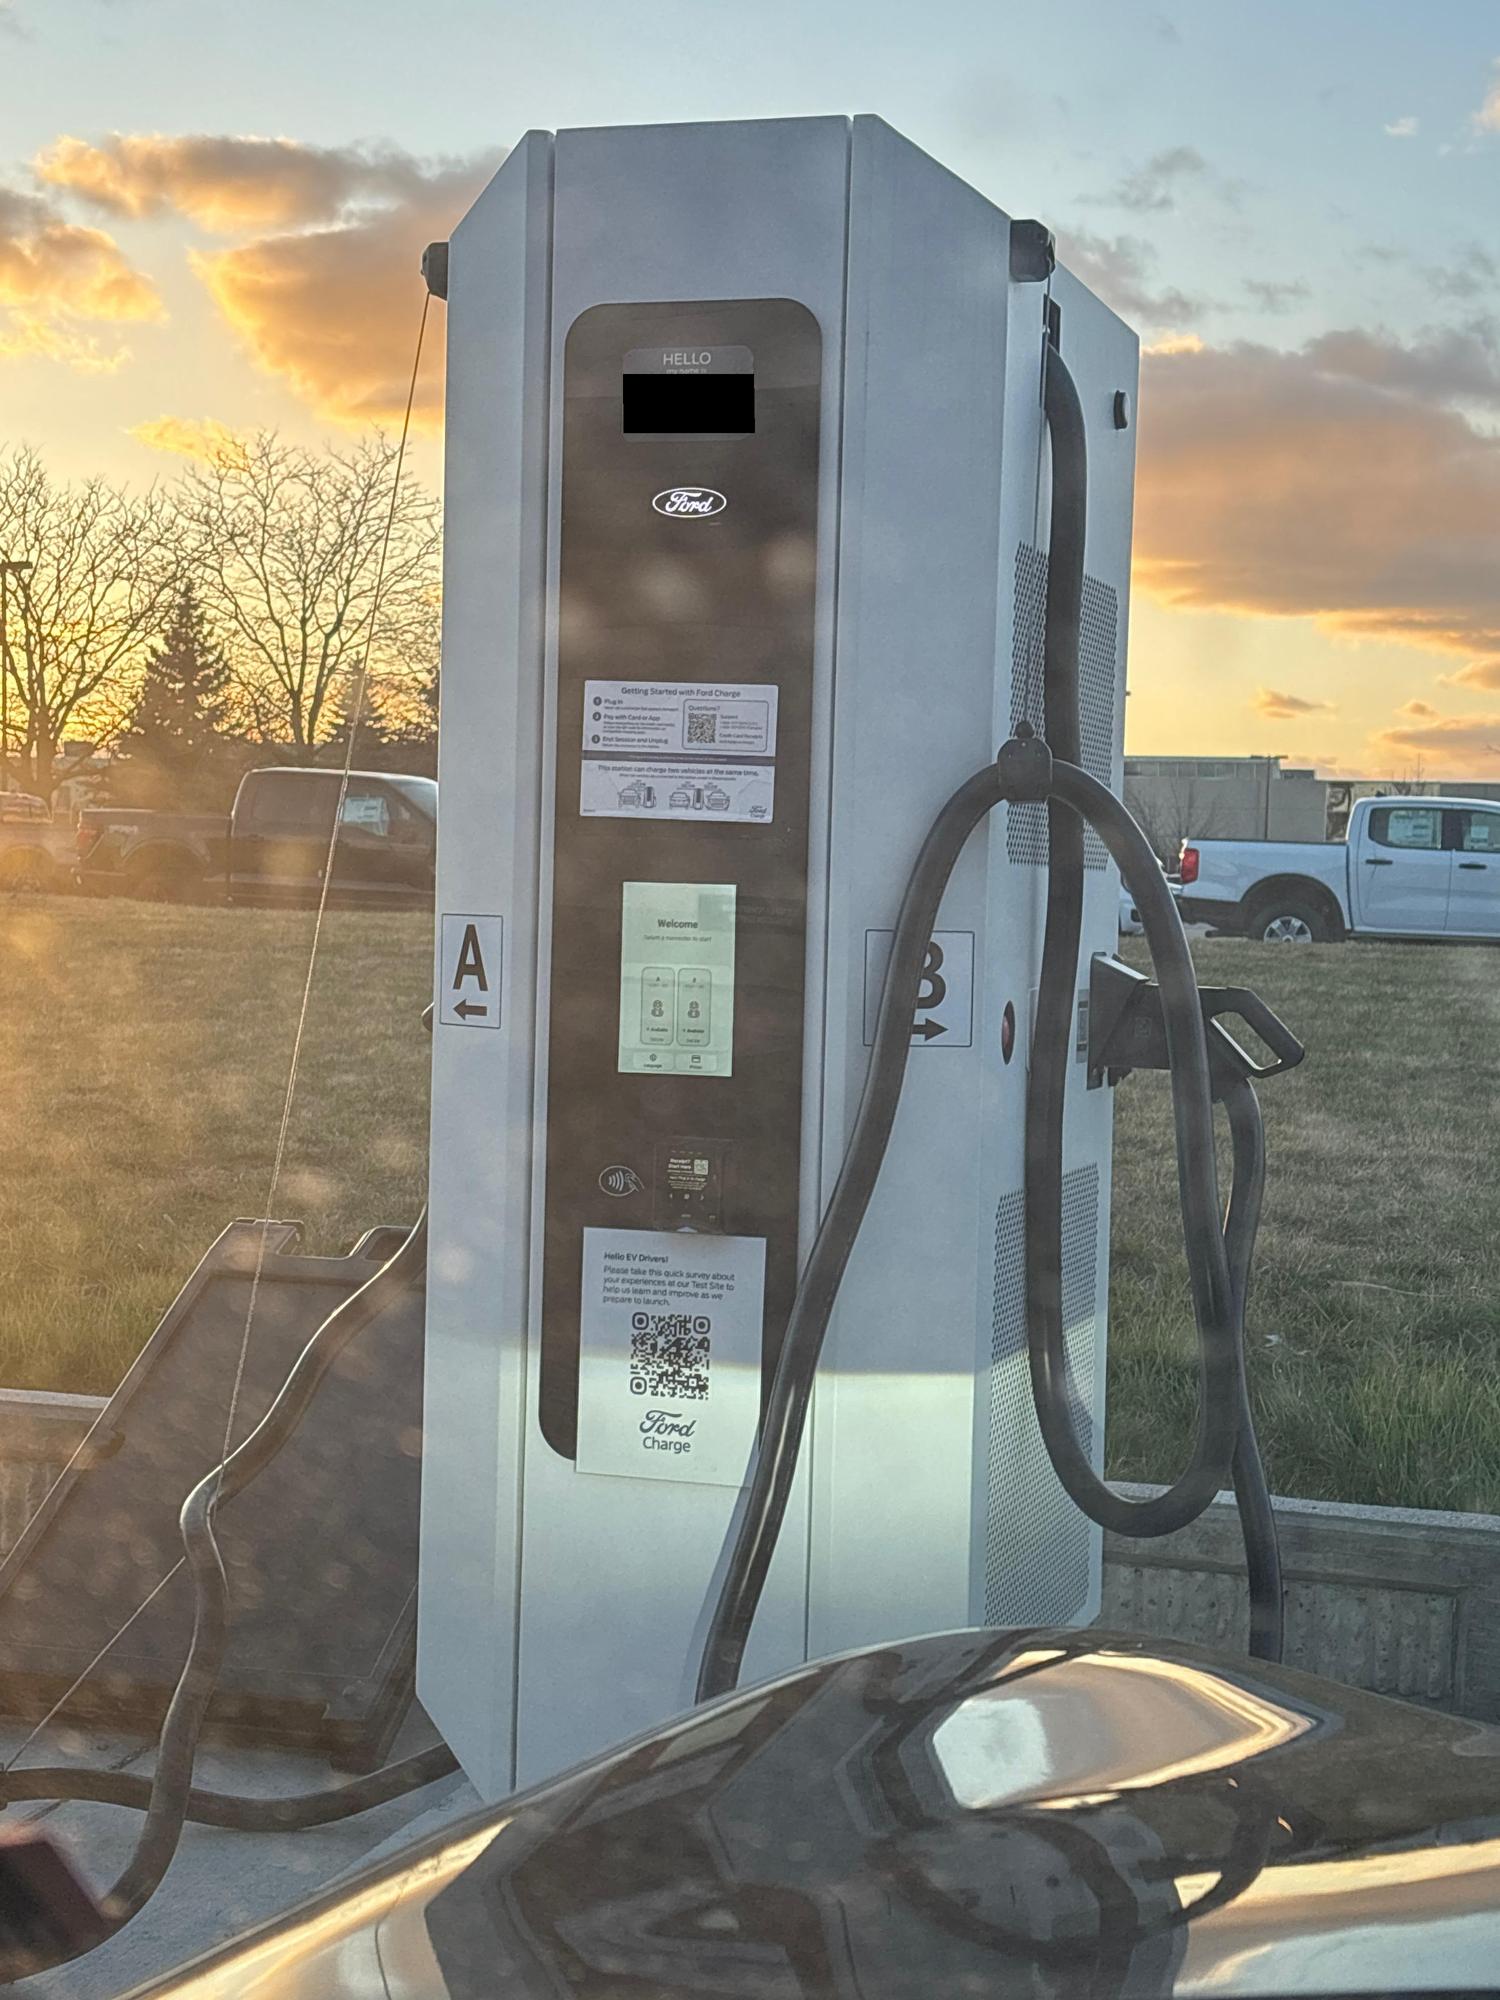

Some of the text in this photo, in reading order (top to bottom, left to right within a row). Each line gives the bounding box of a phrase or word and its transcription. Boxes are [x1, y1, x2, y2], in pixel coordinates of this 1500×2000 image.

[663, 352, 711, 365] HELLO
[665, 492, 713, 513] Ford
[621, 687, 649, 697] Getting
[650, 688, 677, 696] Started
[715, 689, 741, 698] Charge
[646, 766, 667, 774] charge
[657, 919, 698, 929] Welcome
[453, 924, 488, 991] A
[917, 941, 946, 1010] B
[604, 1252, 669, 1263] Hello EV Drivers!
[603, 1265, 735, 1281] Please take this quick survey about
[604, 1277, 620, 1285] your
[621, 1278, 666, 1287] experiences
[691, 1281, 708, 1289] Test
[709, 1281, 724, 1290] Site
[726, 1283, 735, 1291] to
[603, 1285, 620, 1294] help
[632, 1287, 651, 1295] learn
[669, 1290, 699, 1298] improve
[603, 1296, 633, 1304] prepare
[643, 1297, 670, 1306] launch.
[639, 1409, 697, 1437] Ford
[642, 1436, 691, 1454] Charge
